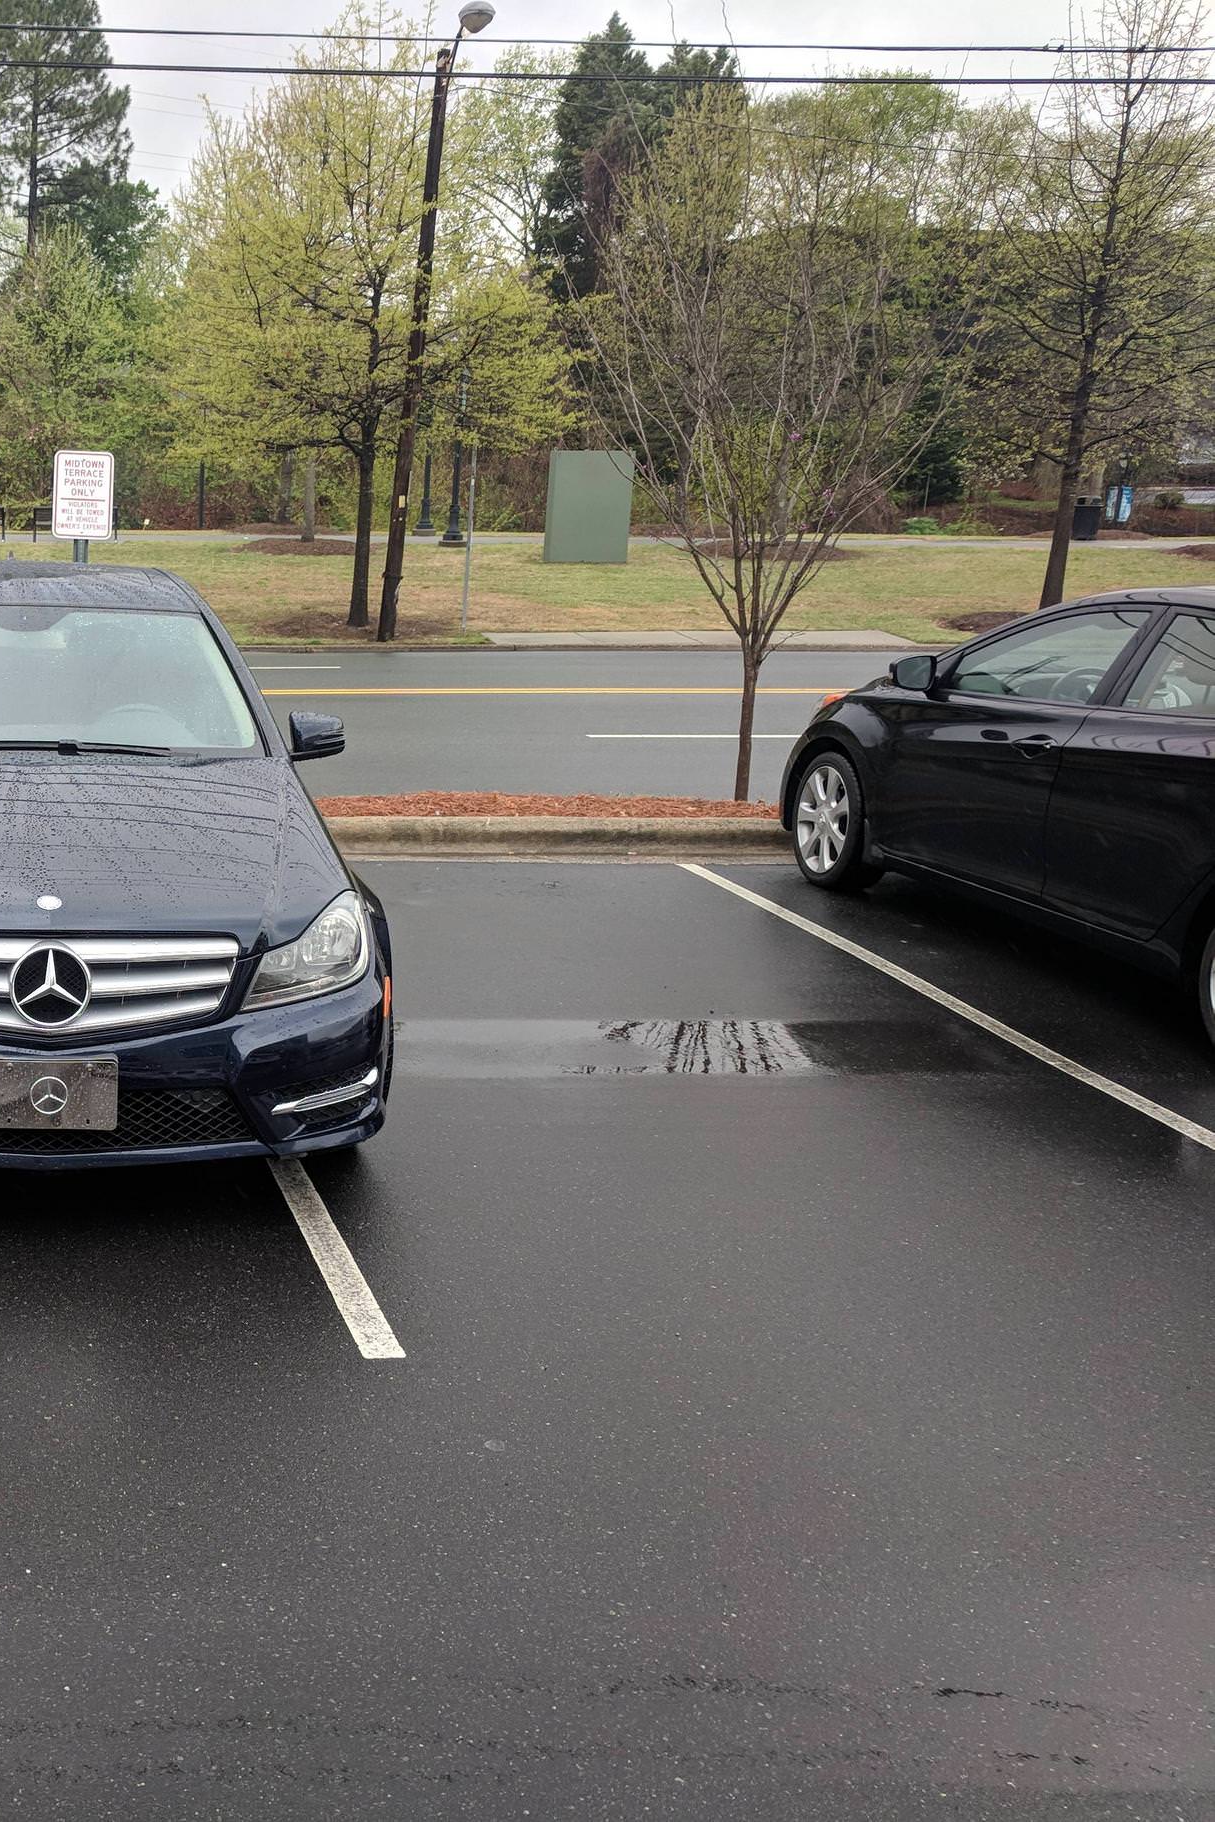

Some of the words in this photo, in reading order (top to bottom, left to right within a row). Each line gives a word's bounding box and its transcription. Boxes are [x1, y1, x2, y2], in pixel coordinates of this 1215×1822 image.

[64, 459, 104, 469] MIDTOWN
[64, 468, 104, 478] TERRACE
[64, 478, 103, 488] PARKING
[71, 488, 95, 497] ONLY
